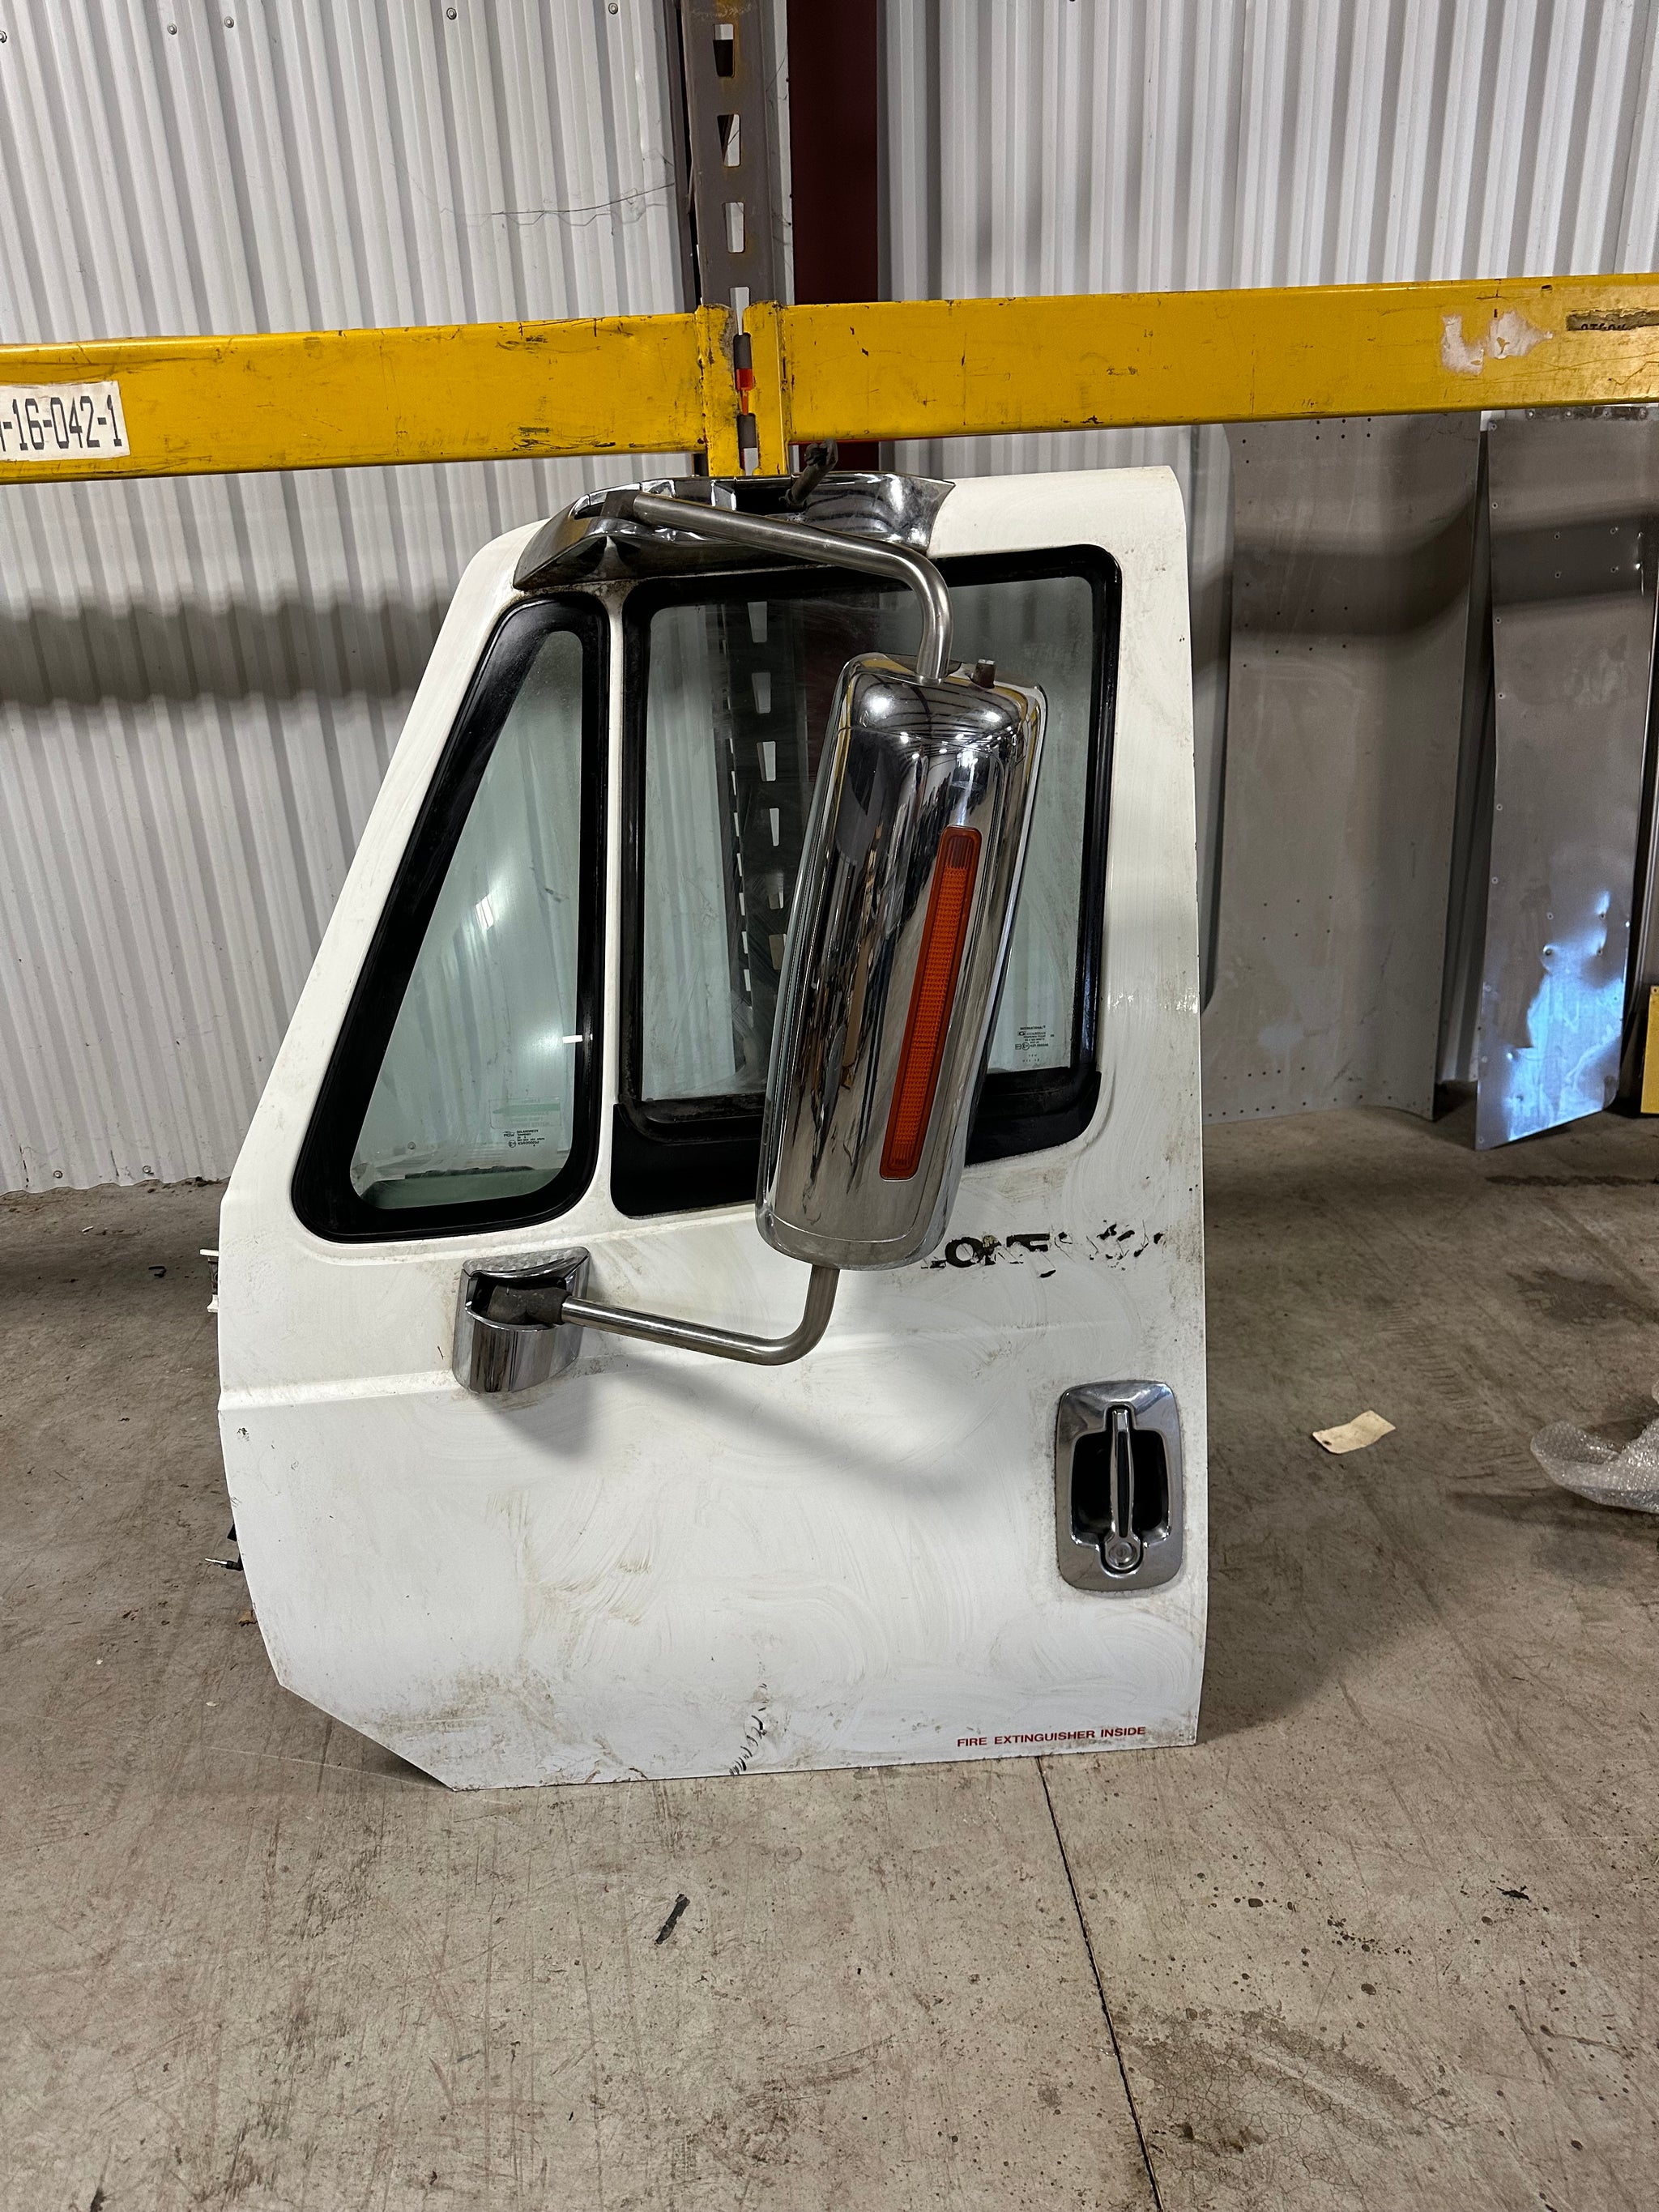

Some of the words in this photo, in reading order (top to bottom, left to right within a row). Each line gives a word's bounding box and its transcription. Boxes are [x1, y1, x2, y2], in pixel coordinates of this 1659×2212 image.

[0, 394, 122, 452] -16-042-1
[957, 1737, 987, 1747] FIRE
[994, 1730, 1095, 1745] EXTINGUISHER
[1100, 1726, 1146, 1738] INSIDE
